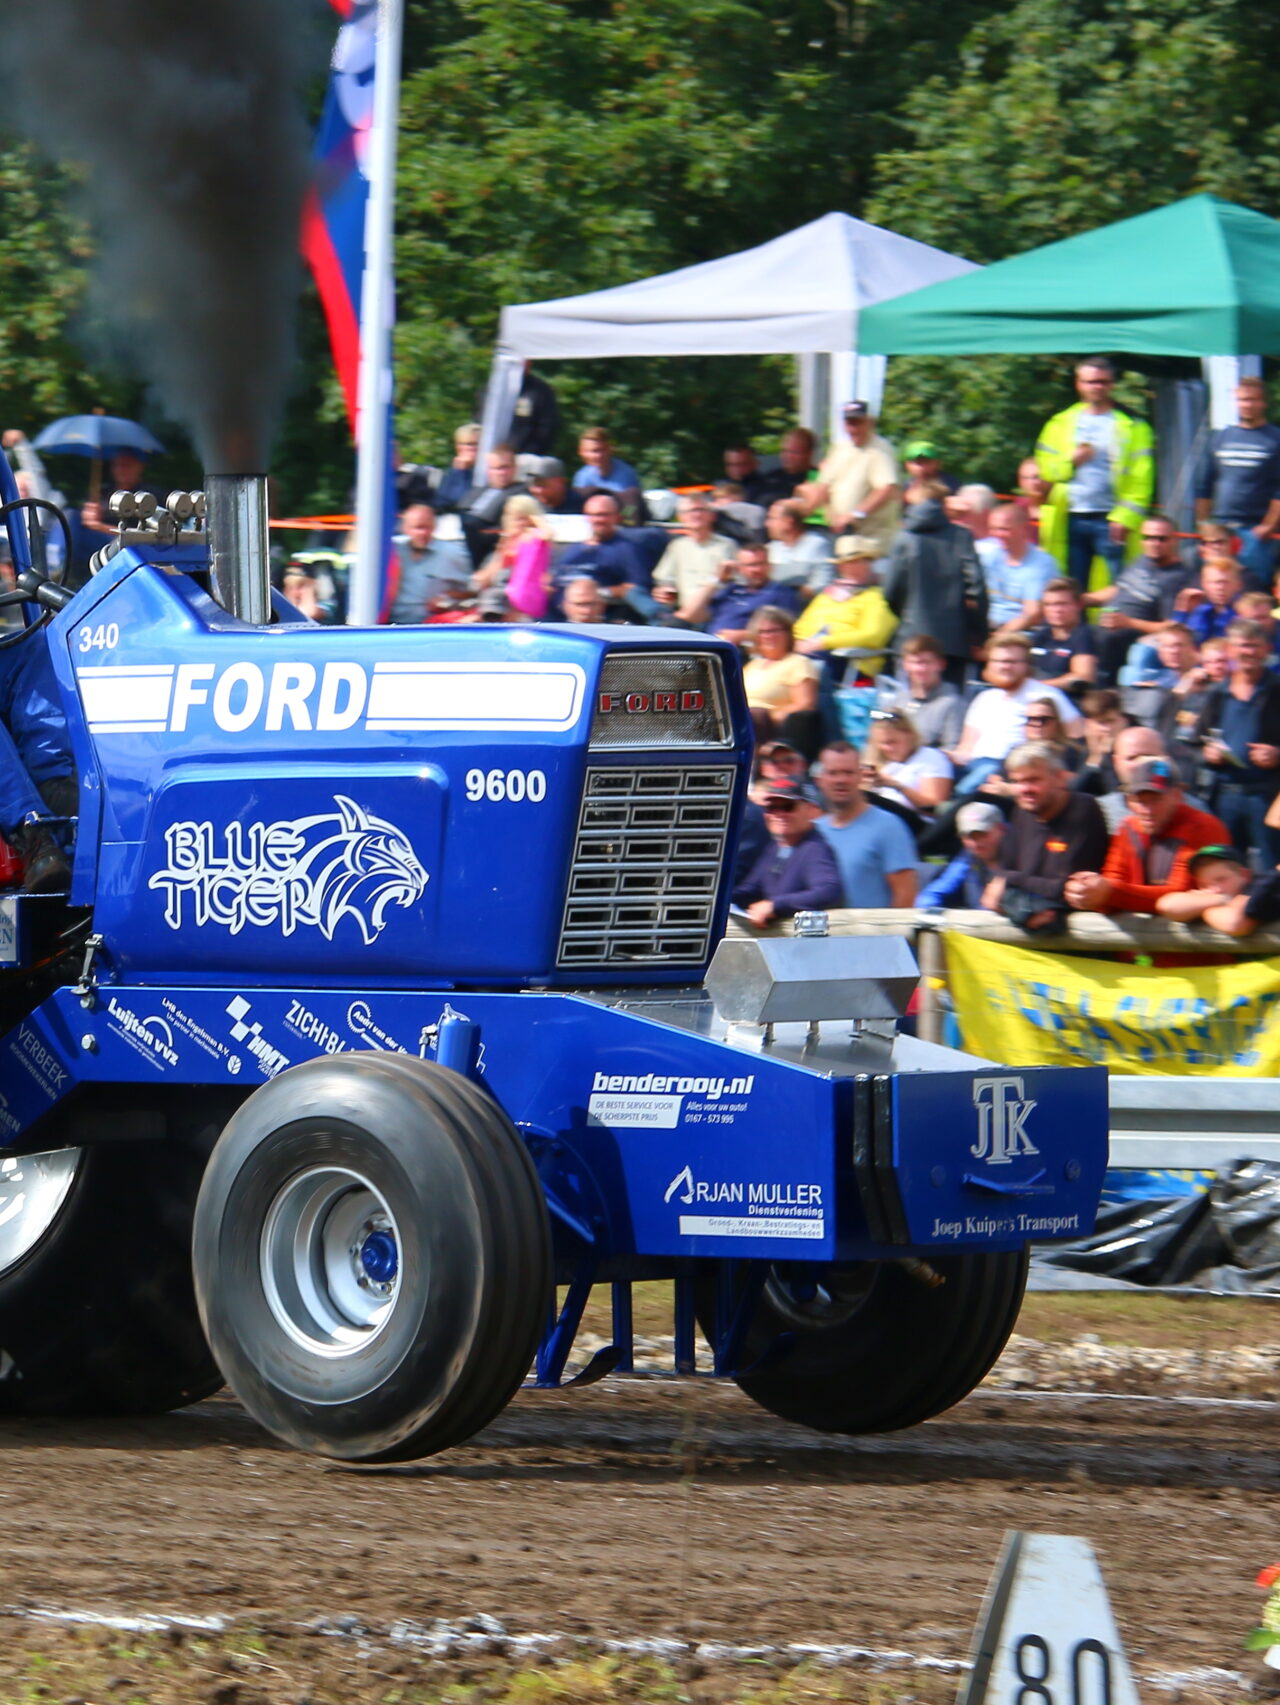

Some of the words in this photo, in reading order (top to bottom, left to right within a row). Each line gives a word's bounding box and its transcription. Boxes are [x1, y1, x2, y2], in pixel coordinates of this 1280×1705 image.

[79, 623, 119, 652] 340
[170, 661, 367, 732] FORD
[599, 689, 705, 713] FORD
[465, 769, 546, 802] 9600
[164, 820, 306, 873] BLUE
[148, 870, 320, 938] TIGER
[108, 997, 154, 1046] Luijten
[18, 1022, 69, 1089] VERBEEK
[246, 1035, 290, 1072] HMT
[592, 1072, 755, 1100] benderooy.nl
[748, 1183, 823, 1205] MULLER
[931, 1218, 962, 1239] Joep
[1017, 1214, 1080, 1235] Transport
[1015, 1634, 1112, 1705] 80
